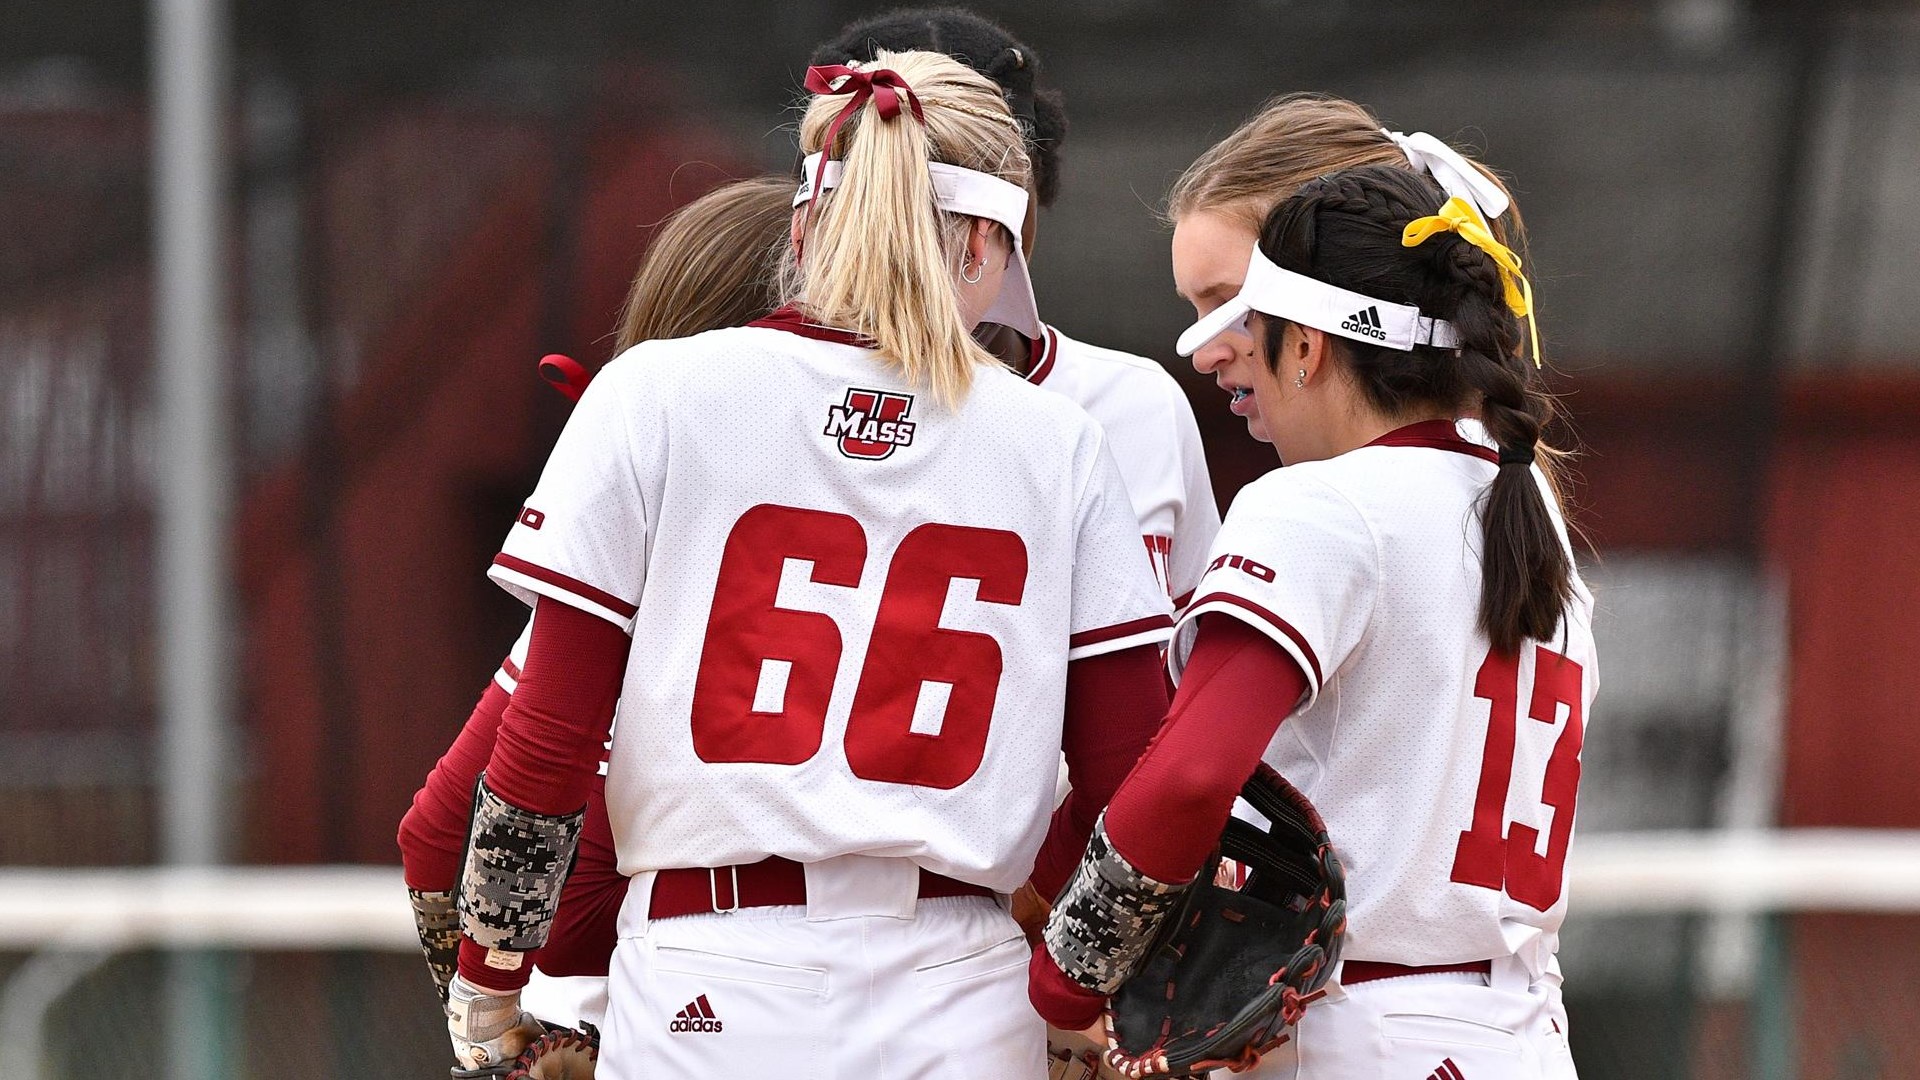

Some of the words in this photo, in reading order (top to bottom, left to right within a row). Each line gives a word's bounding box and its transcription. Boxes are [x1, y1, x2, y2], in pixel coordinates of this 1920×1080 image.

[1341, 320, 1387, 341] adidas
[691, 503, 1028, 790] 66
[1450, 644, 1584, 912] 13
[670, 1017, 723, 1033] adidas
